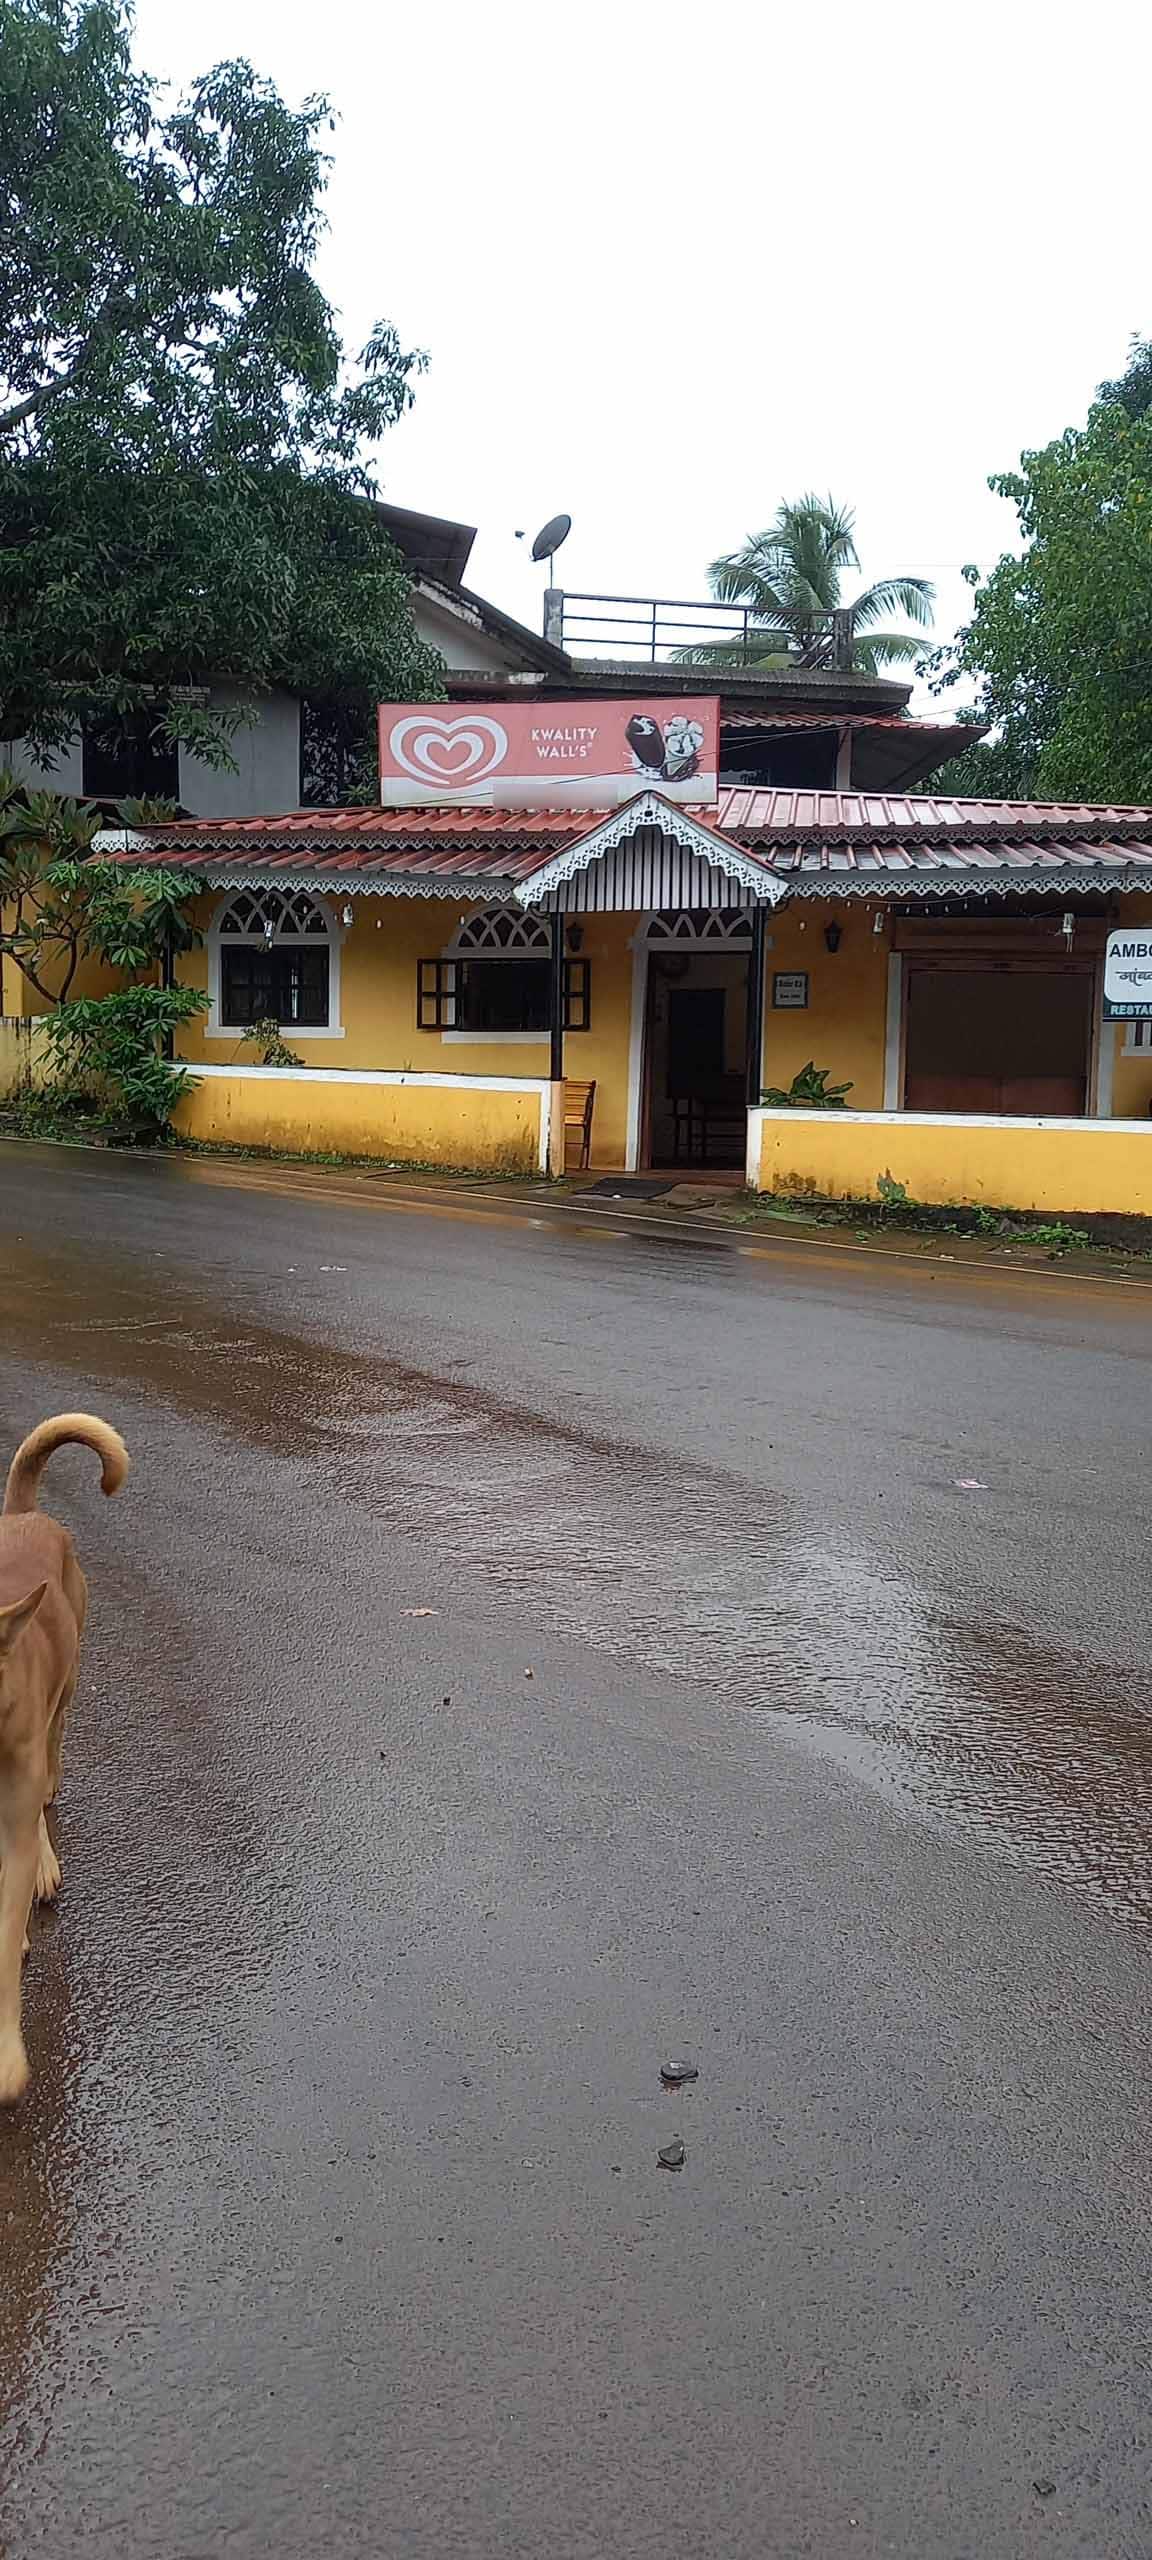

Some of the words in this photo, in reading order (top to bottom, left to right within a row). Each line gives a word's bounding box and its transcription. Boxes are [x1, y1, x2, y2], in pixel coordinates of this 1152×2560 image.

[531, 727, 598, 741] KWALITY
[536, 744, 587, 758] WALL'S
[1109, 943, 1152, 958] AMB
